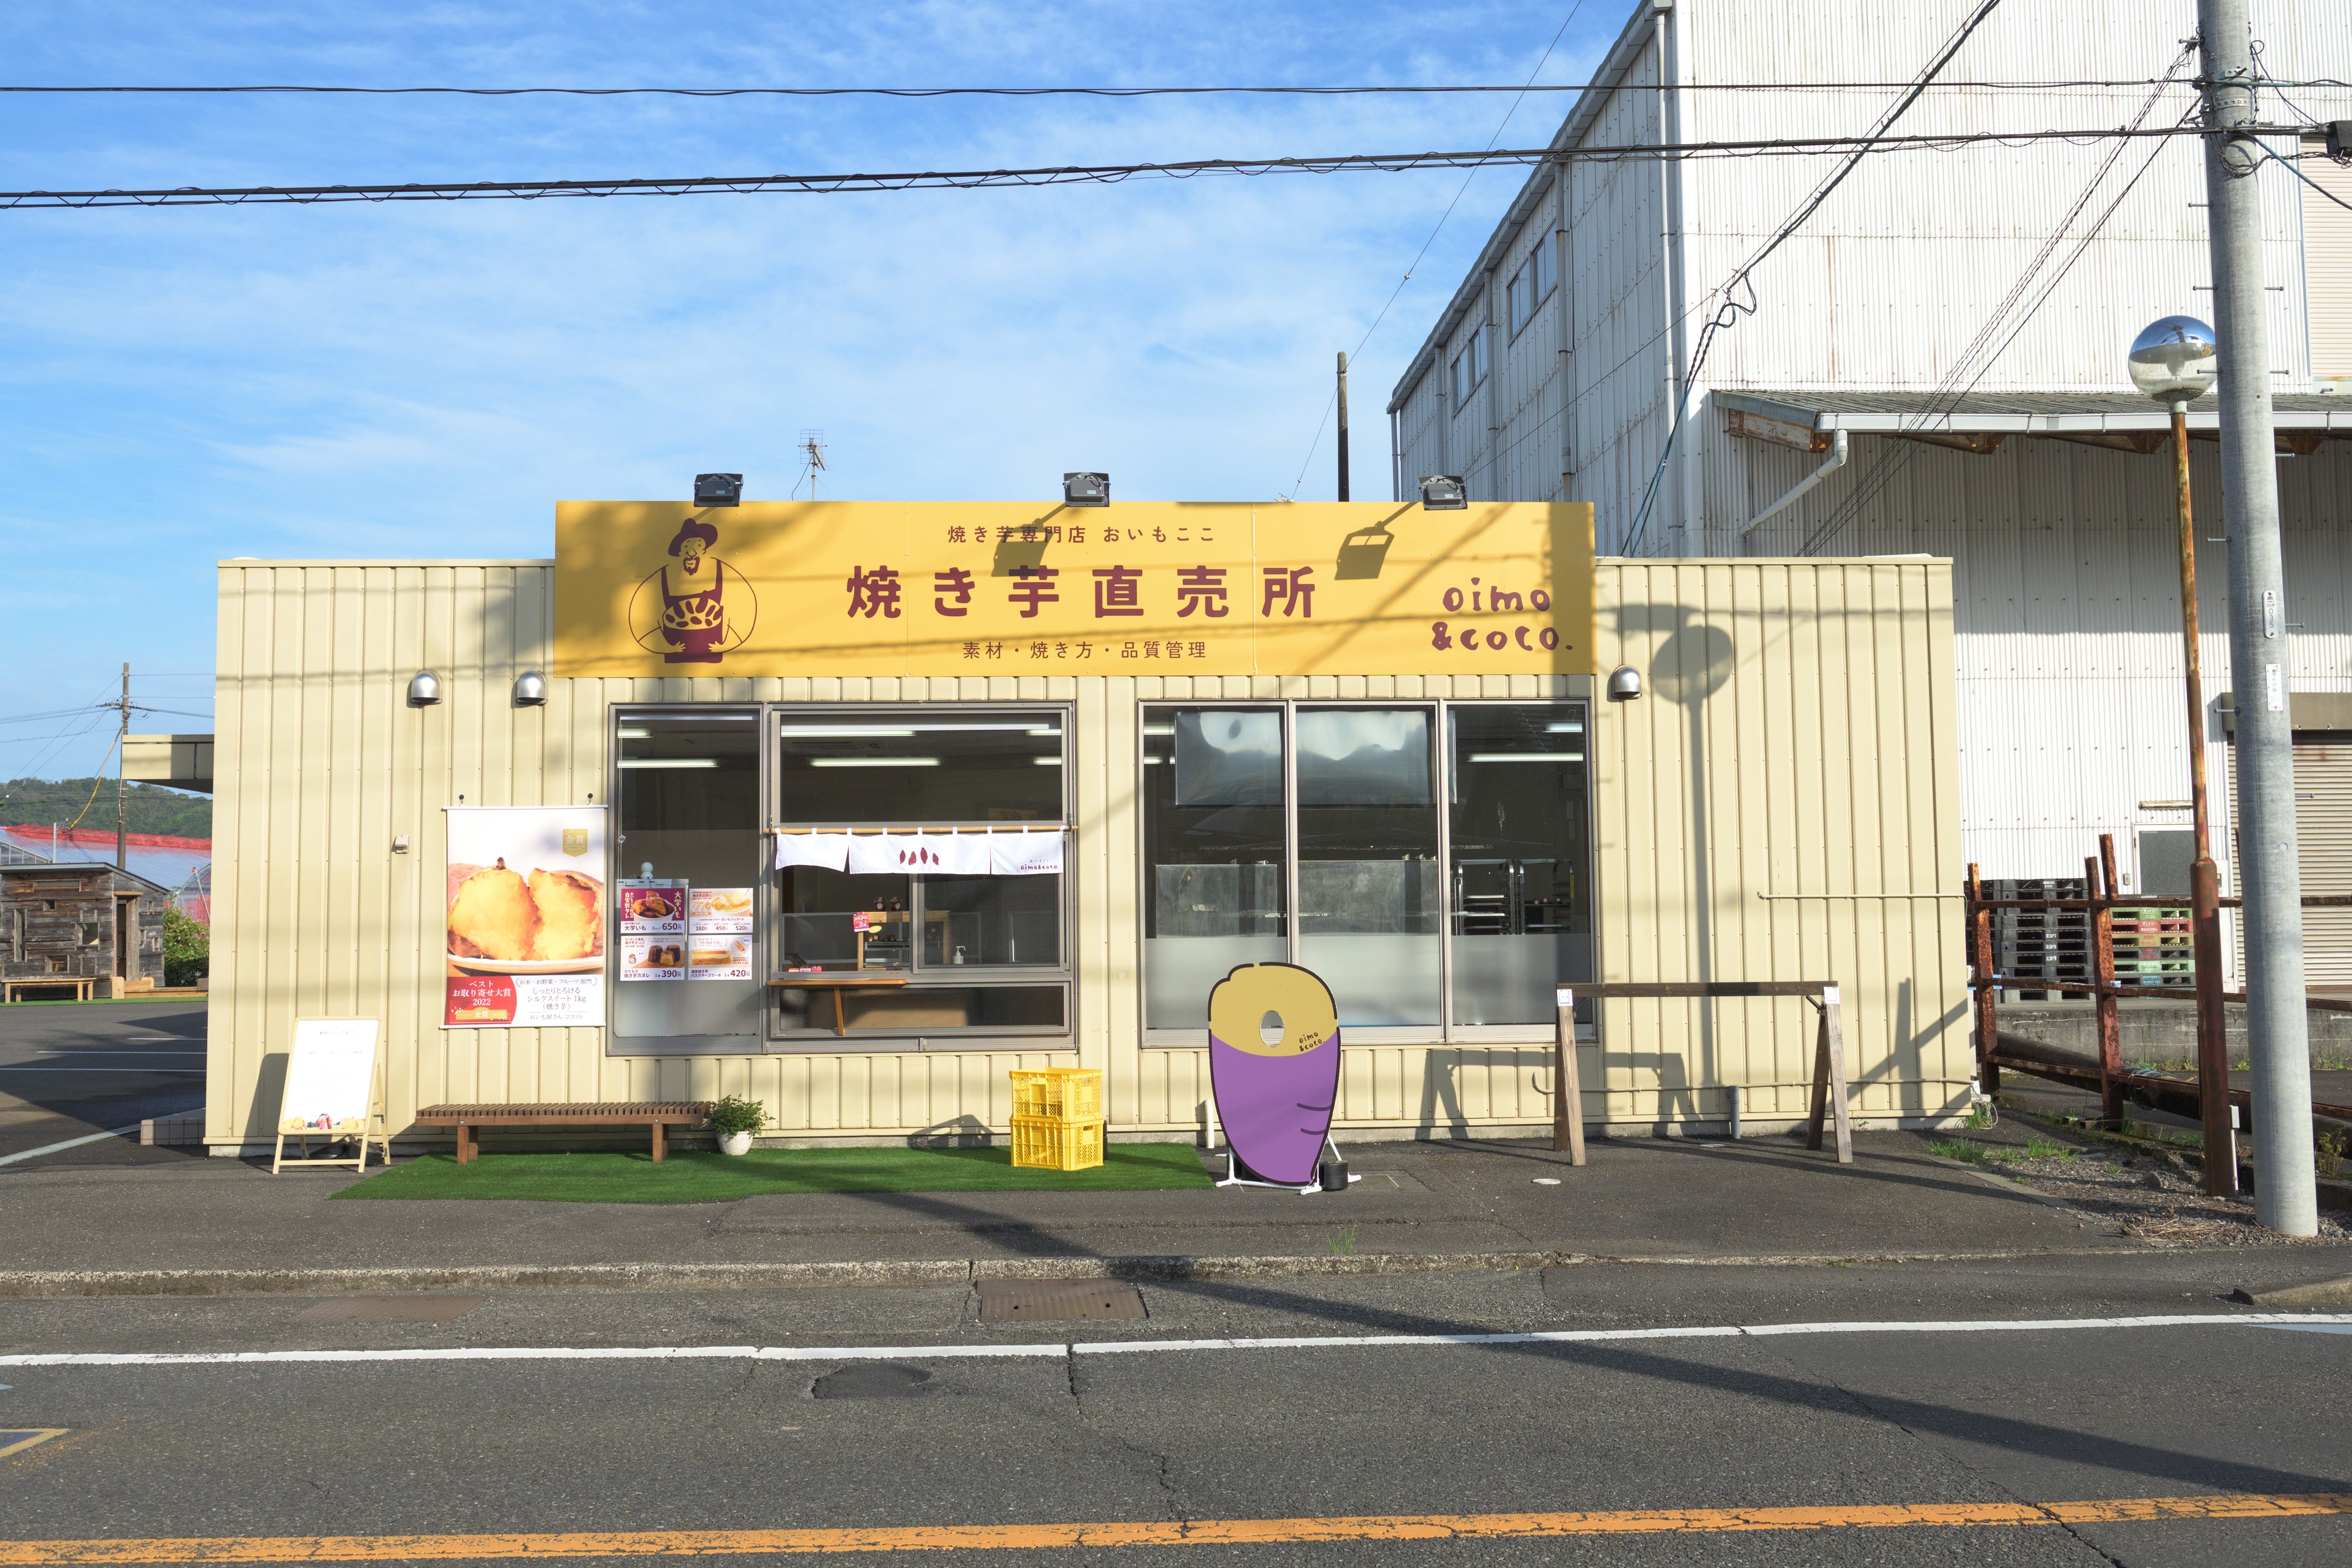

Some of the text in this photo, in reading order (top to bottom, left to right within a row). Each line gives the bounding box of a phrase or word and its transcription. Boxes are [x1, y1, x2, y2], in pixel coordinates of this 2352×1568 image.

[948, 526, 1215, 543] 焼き芋専門店 おいもここ
[847, 564, 1315, 618] 焼き芋直売所
[1442, 577, 1551, 612] oimo
[1432, 621, 1573, 651] &coco.
[963, 641, 1207, 660] 素材・焼き方・品質管理
[564, 834, 584, 845] 金賞
[674, 891, 682, 918] 大学いも
[452, 988, 512, 998] お取り寄せ大賞
[574, 995, 587, 1003] 1kg
[1299, 1031, 1318, 1044] oimo
